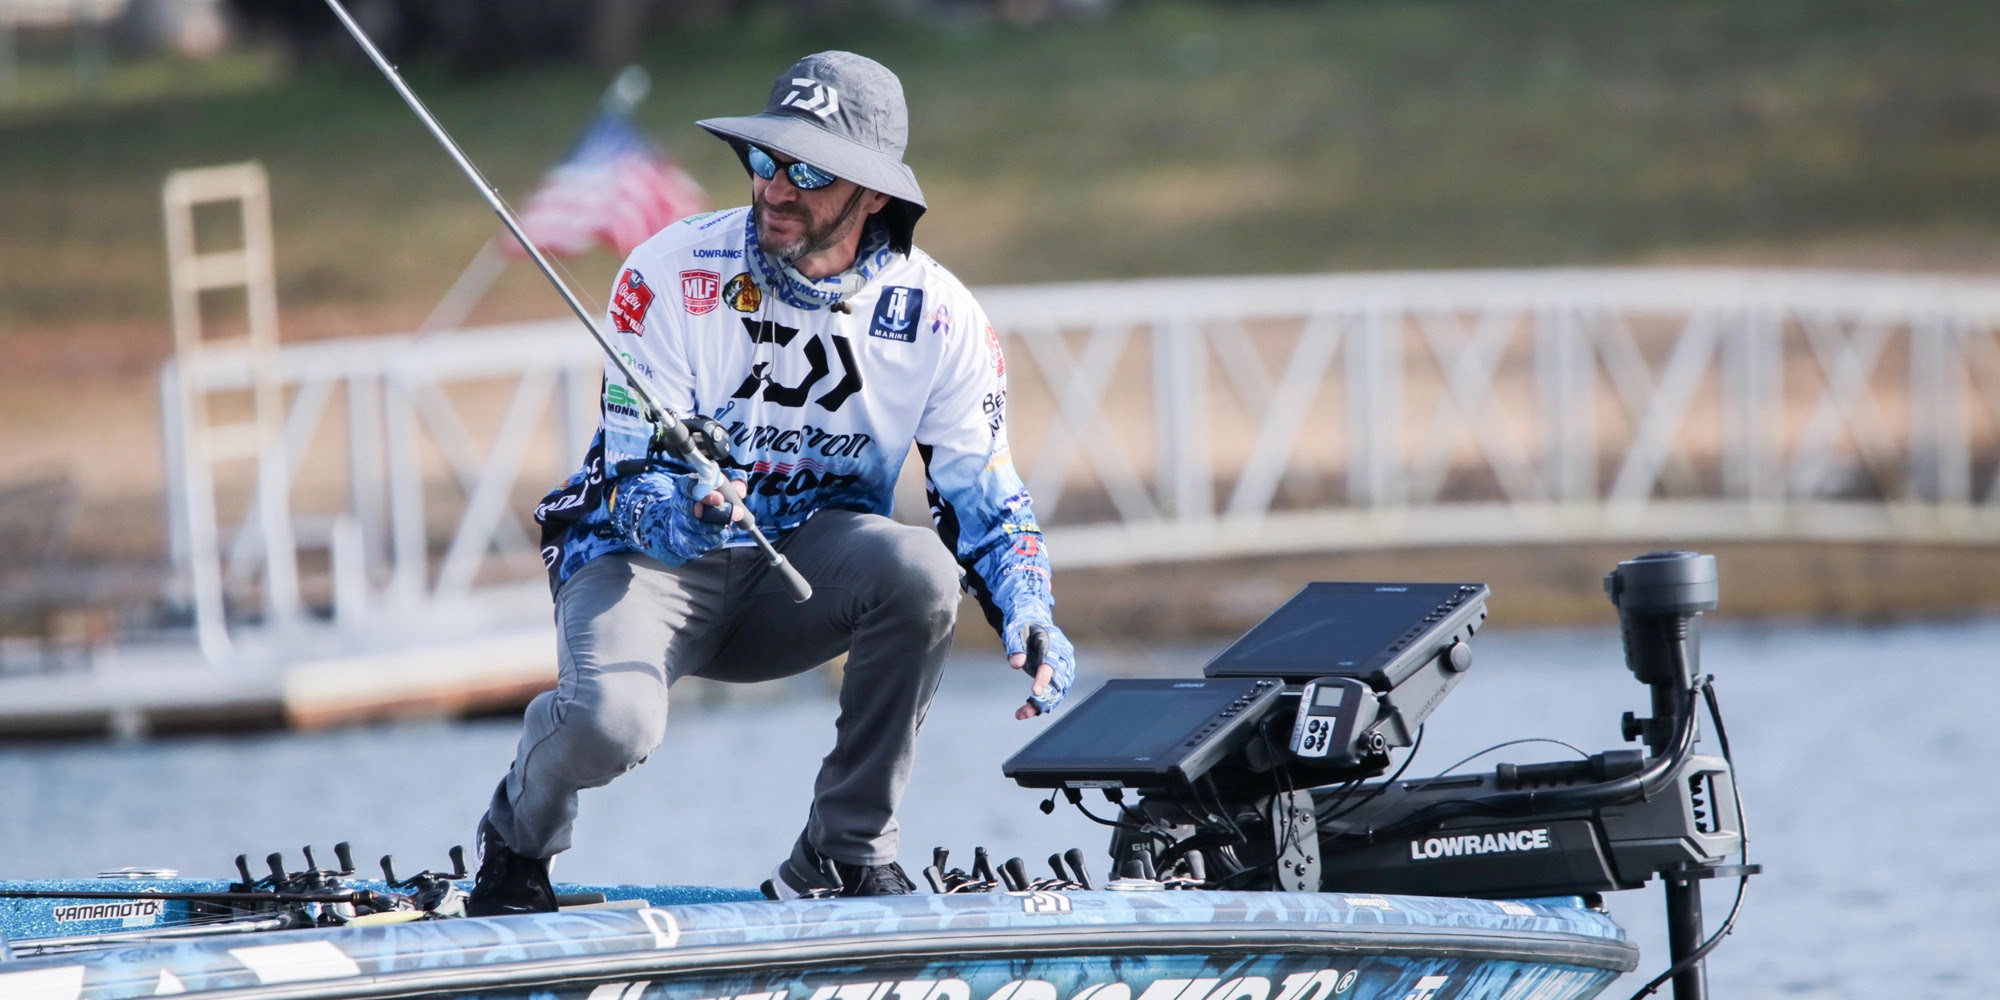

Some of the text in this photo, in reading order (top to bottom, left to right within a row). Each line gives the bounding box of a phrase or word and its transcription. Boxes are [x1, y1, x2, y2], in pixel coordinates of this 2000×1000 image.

[693, 249, 743, 260] LOWRANCE
[684, 278, 716, 299] MLF
[874, 328, 908, 341] MARINE
[1411, 828, 1549, 860] LOWRANCE
[55, 901, 157, 923] YAMAMOTO
[124, 916, 154, 926] BAITS
